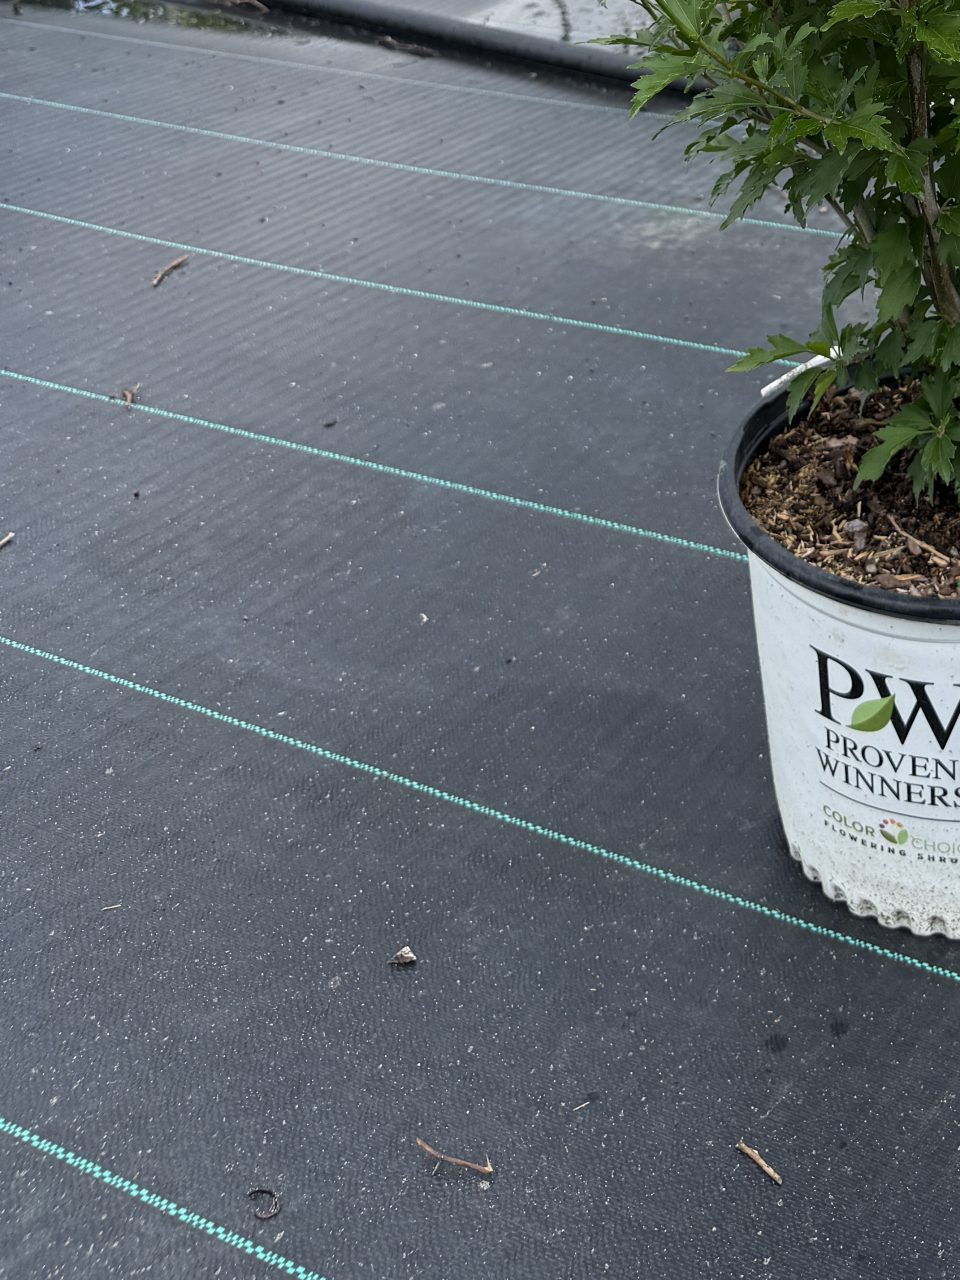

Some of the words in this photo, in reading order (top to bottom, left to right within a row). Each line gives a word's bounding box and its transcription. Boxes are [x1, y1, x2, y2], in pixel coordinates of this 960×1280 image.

[824, 726, 959, 781] PROVEN
[823, 804, 876, 837] COLOR
[824, 819, 907, 857] FLOWERING
